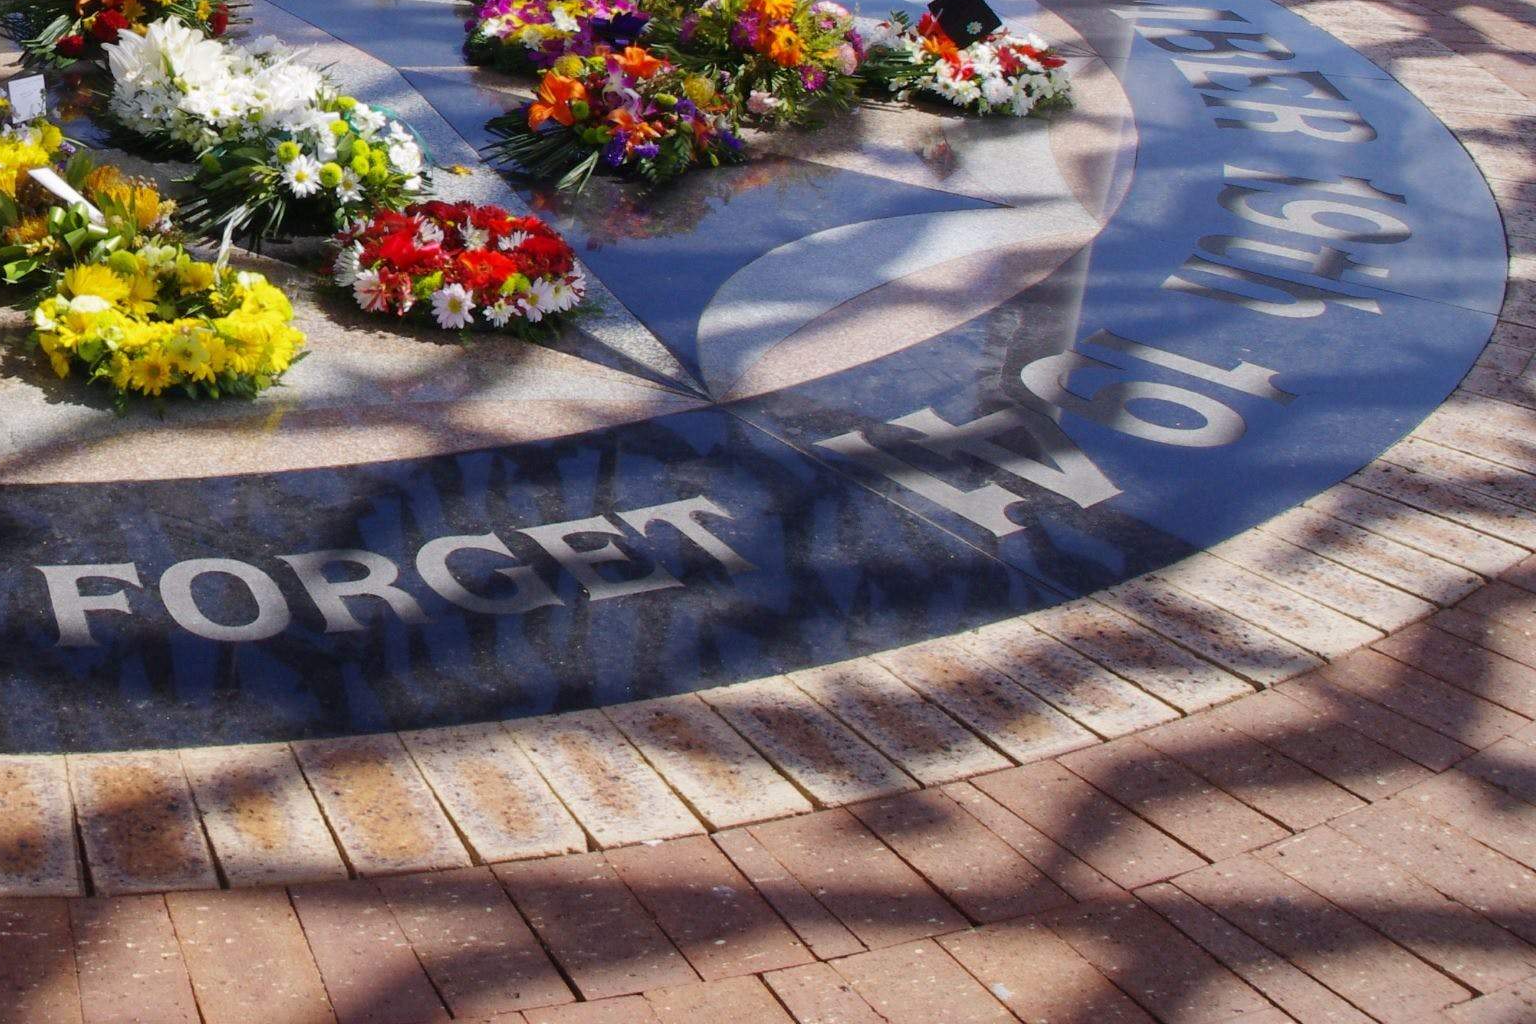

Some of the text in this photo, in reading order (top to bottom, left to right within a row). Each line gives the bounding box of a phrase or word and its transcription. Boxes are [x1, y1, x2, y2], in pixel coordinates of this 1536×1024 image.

[1160, 162, 1413, 319] 19th
[812, 327, 1302, 538] 1941
[35, 494, 762, 648] FORGET
